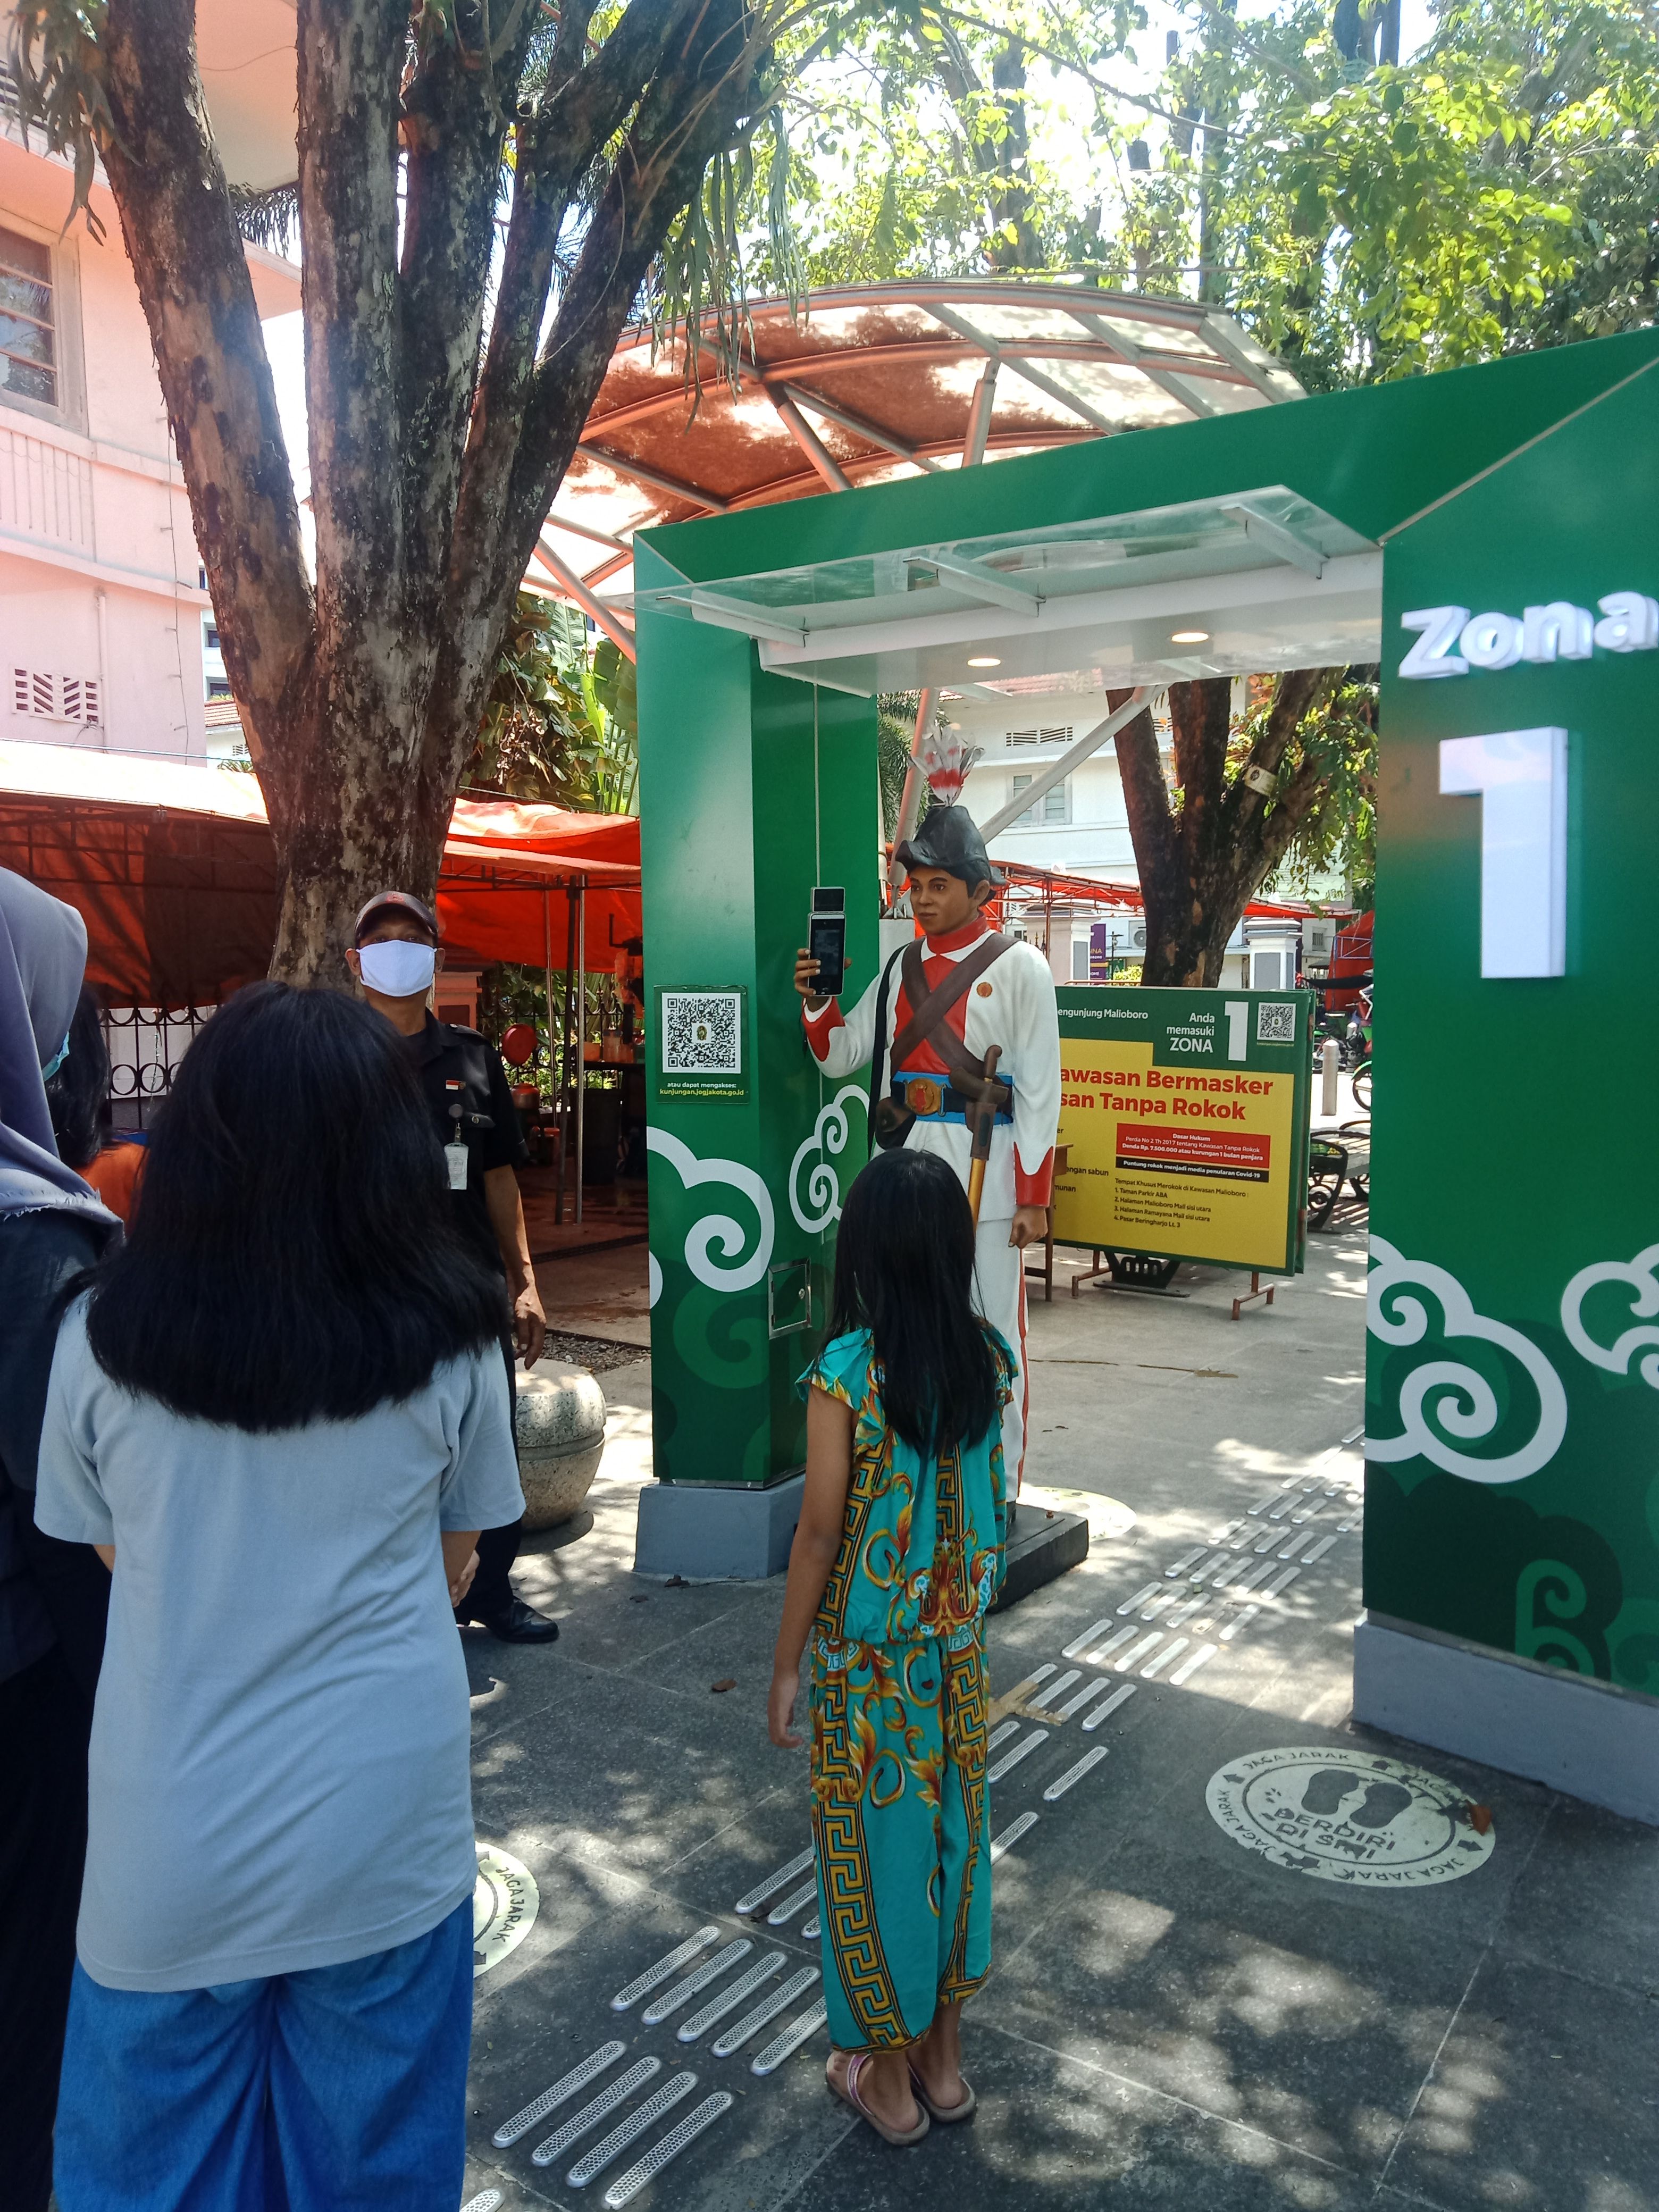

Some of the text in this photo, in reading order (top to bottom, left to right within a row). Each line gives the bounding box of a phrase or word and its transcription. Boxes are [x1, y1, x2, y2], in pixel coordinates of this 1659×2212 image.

[1398, 591, 1659, 680] Zona
[1439, 726, 1568, 979] 1
[1058, 1008, 1149, 1019] engunjung Malioboro
[1189, 1012, 1215, 1023] Anda
[1166, 1026, 1214, 1036] memasuki
[1225, 1001, 1249, 1061] 1
[1170, 1037, 1213, 1053] ZONA
[1060, 1068, 1273, 1095] awasan Bermasker
[1060, 1092, 1246, 1120] san Tanpa Rokok
[1088, 1168, 1109, 1176] sabun
[1216, 1188, 1246, 1197] Malioboro
[1144, 1200, 1174, 1208] Malioboro
[1144, 1209, 1172, 1218] Ramayana
[1135, 1218, 1168, 1227] Beringharjo
[1242, 1755, 1285, 1770] JAGA
[1276, 1822, 1309, 1839] DI
[1416, 1857, 1465, 1878] JAGA
[492, 1867, 525, 1942] JAGA JARAK
